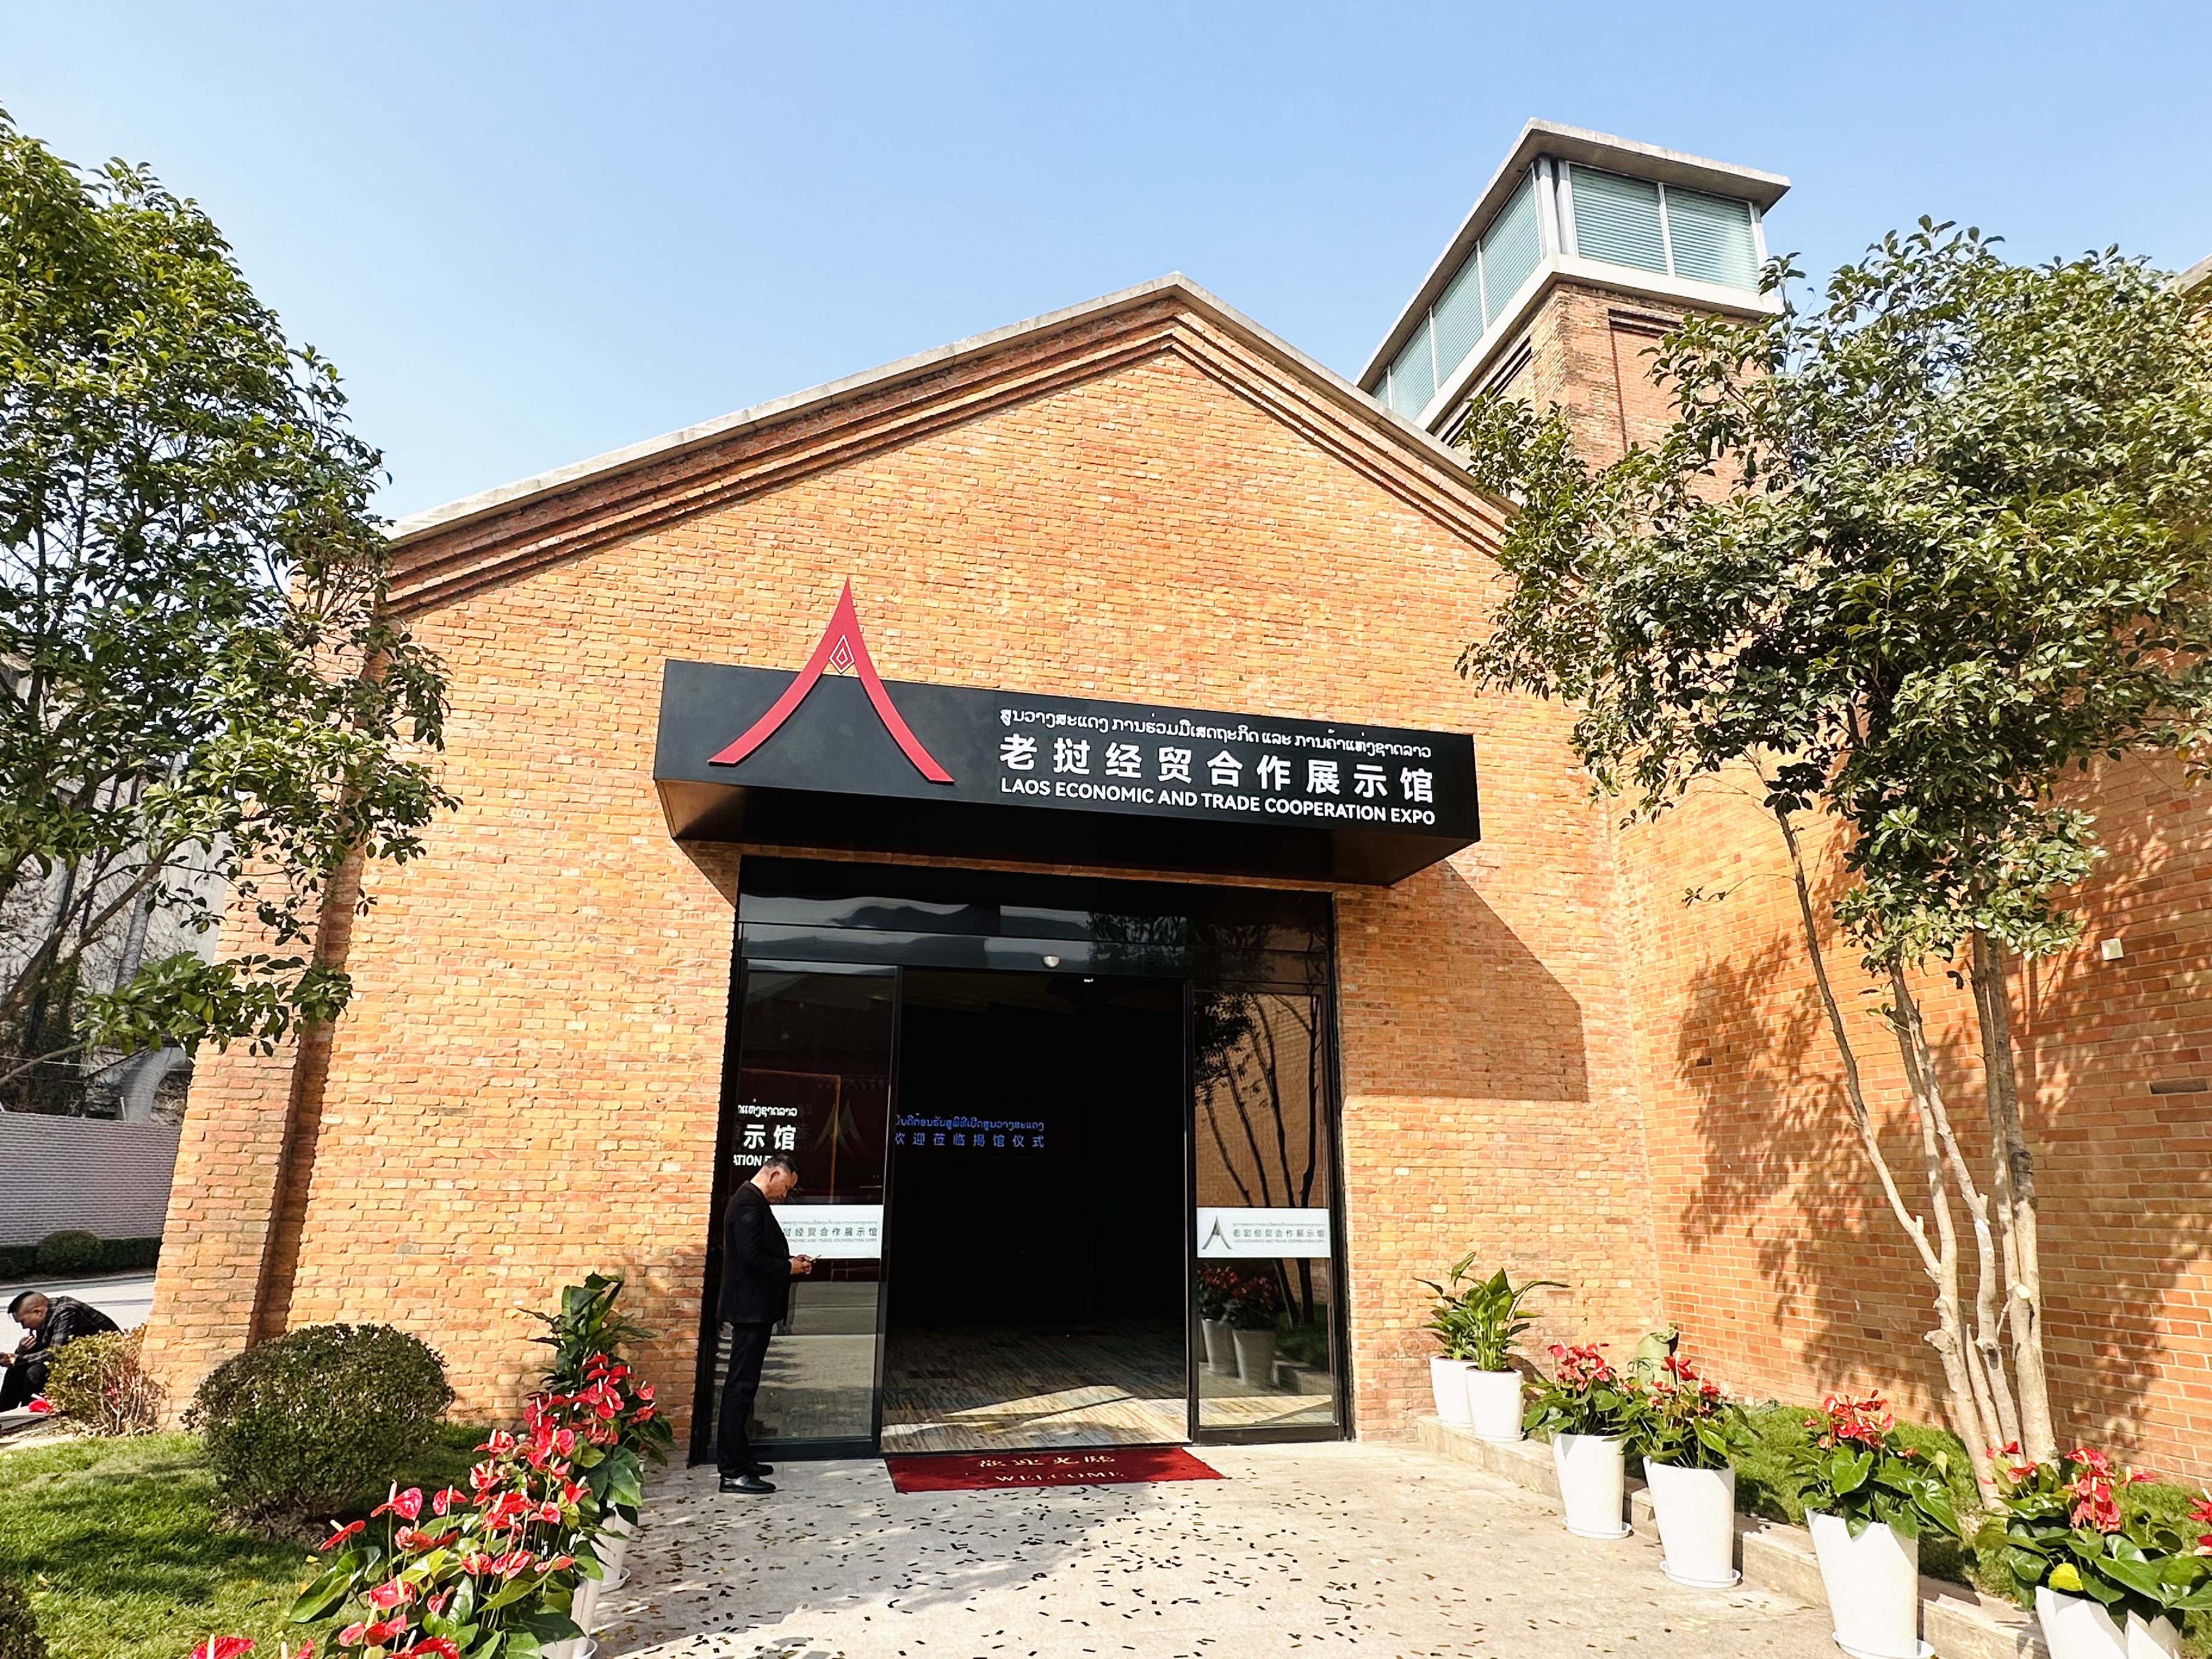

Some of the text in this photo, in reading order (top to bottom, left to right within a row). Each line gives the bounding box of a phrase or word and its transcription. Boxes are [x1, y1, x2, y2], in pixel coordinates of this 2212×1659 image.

[1262, 732, 1292, 745] ແລະ
[999, 733, 1433, 803] 老挝经贸合作展示馆
[1001, 777, 1435, 825] LAOS ECONOMIC AND TRADE COOPERATION EXPO
[743, 1123, 797, 1151] 示馆
